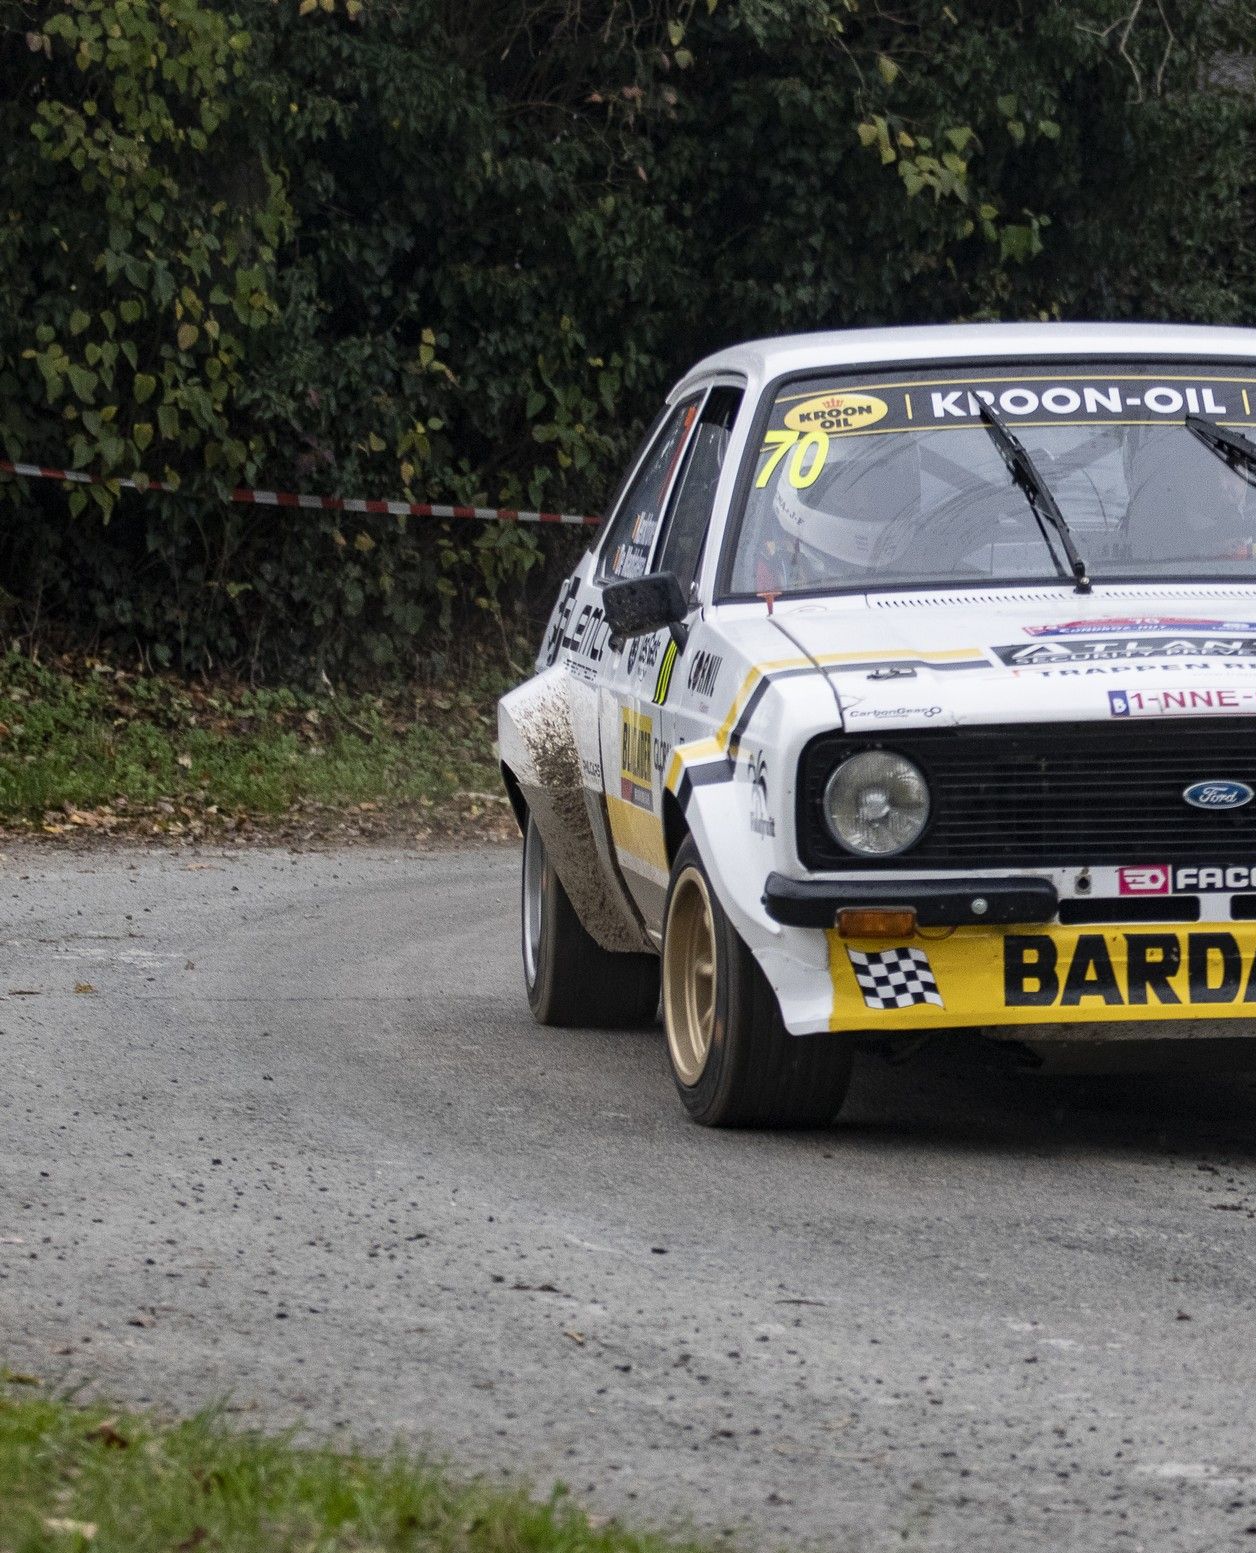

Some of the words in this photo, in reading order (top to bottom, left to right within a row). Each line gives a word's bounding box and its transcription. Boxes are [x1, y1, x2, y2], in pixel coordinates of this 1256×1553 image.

[930, 387, 1227, 418] KROON-OIL
[799, 405, 873, 423] KROON
[820, 418, 853, 429] OIL
[755, 430, 830, 489] 70
[1041, 664, 1211, 678] TRAPPEN
[1200, 786, 1239, 803] Ford
